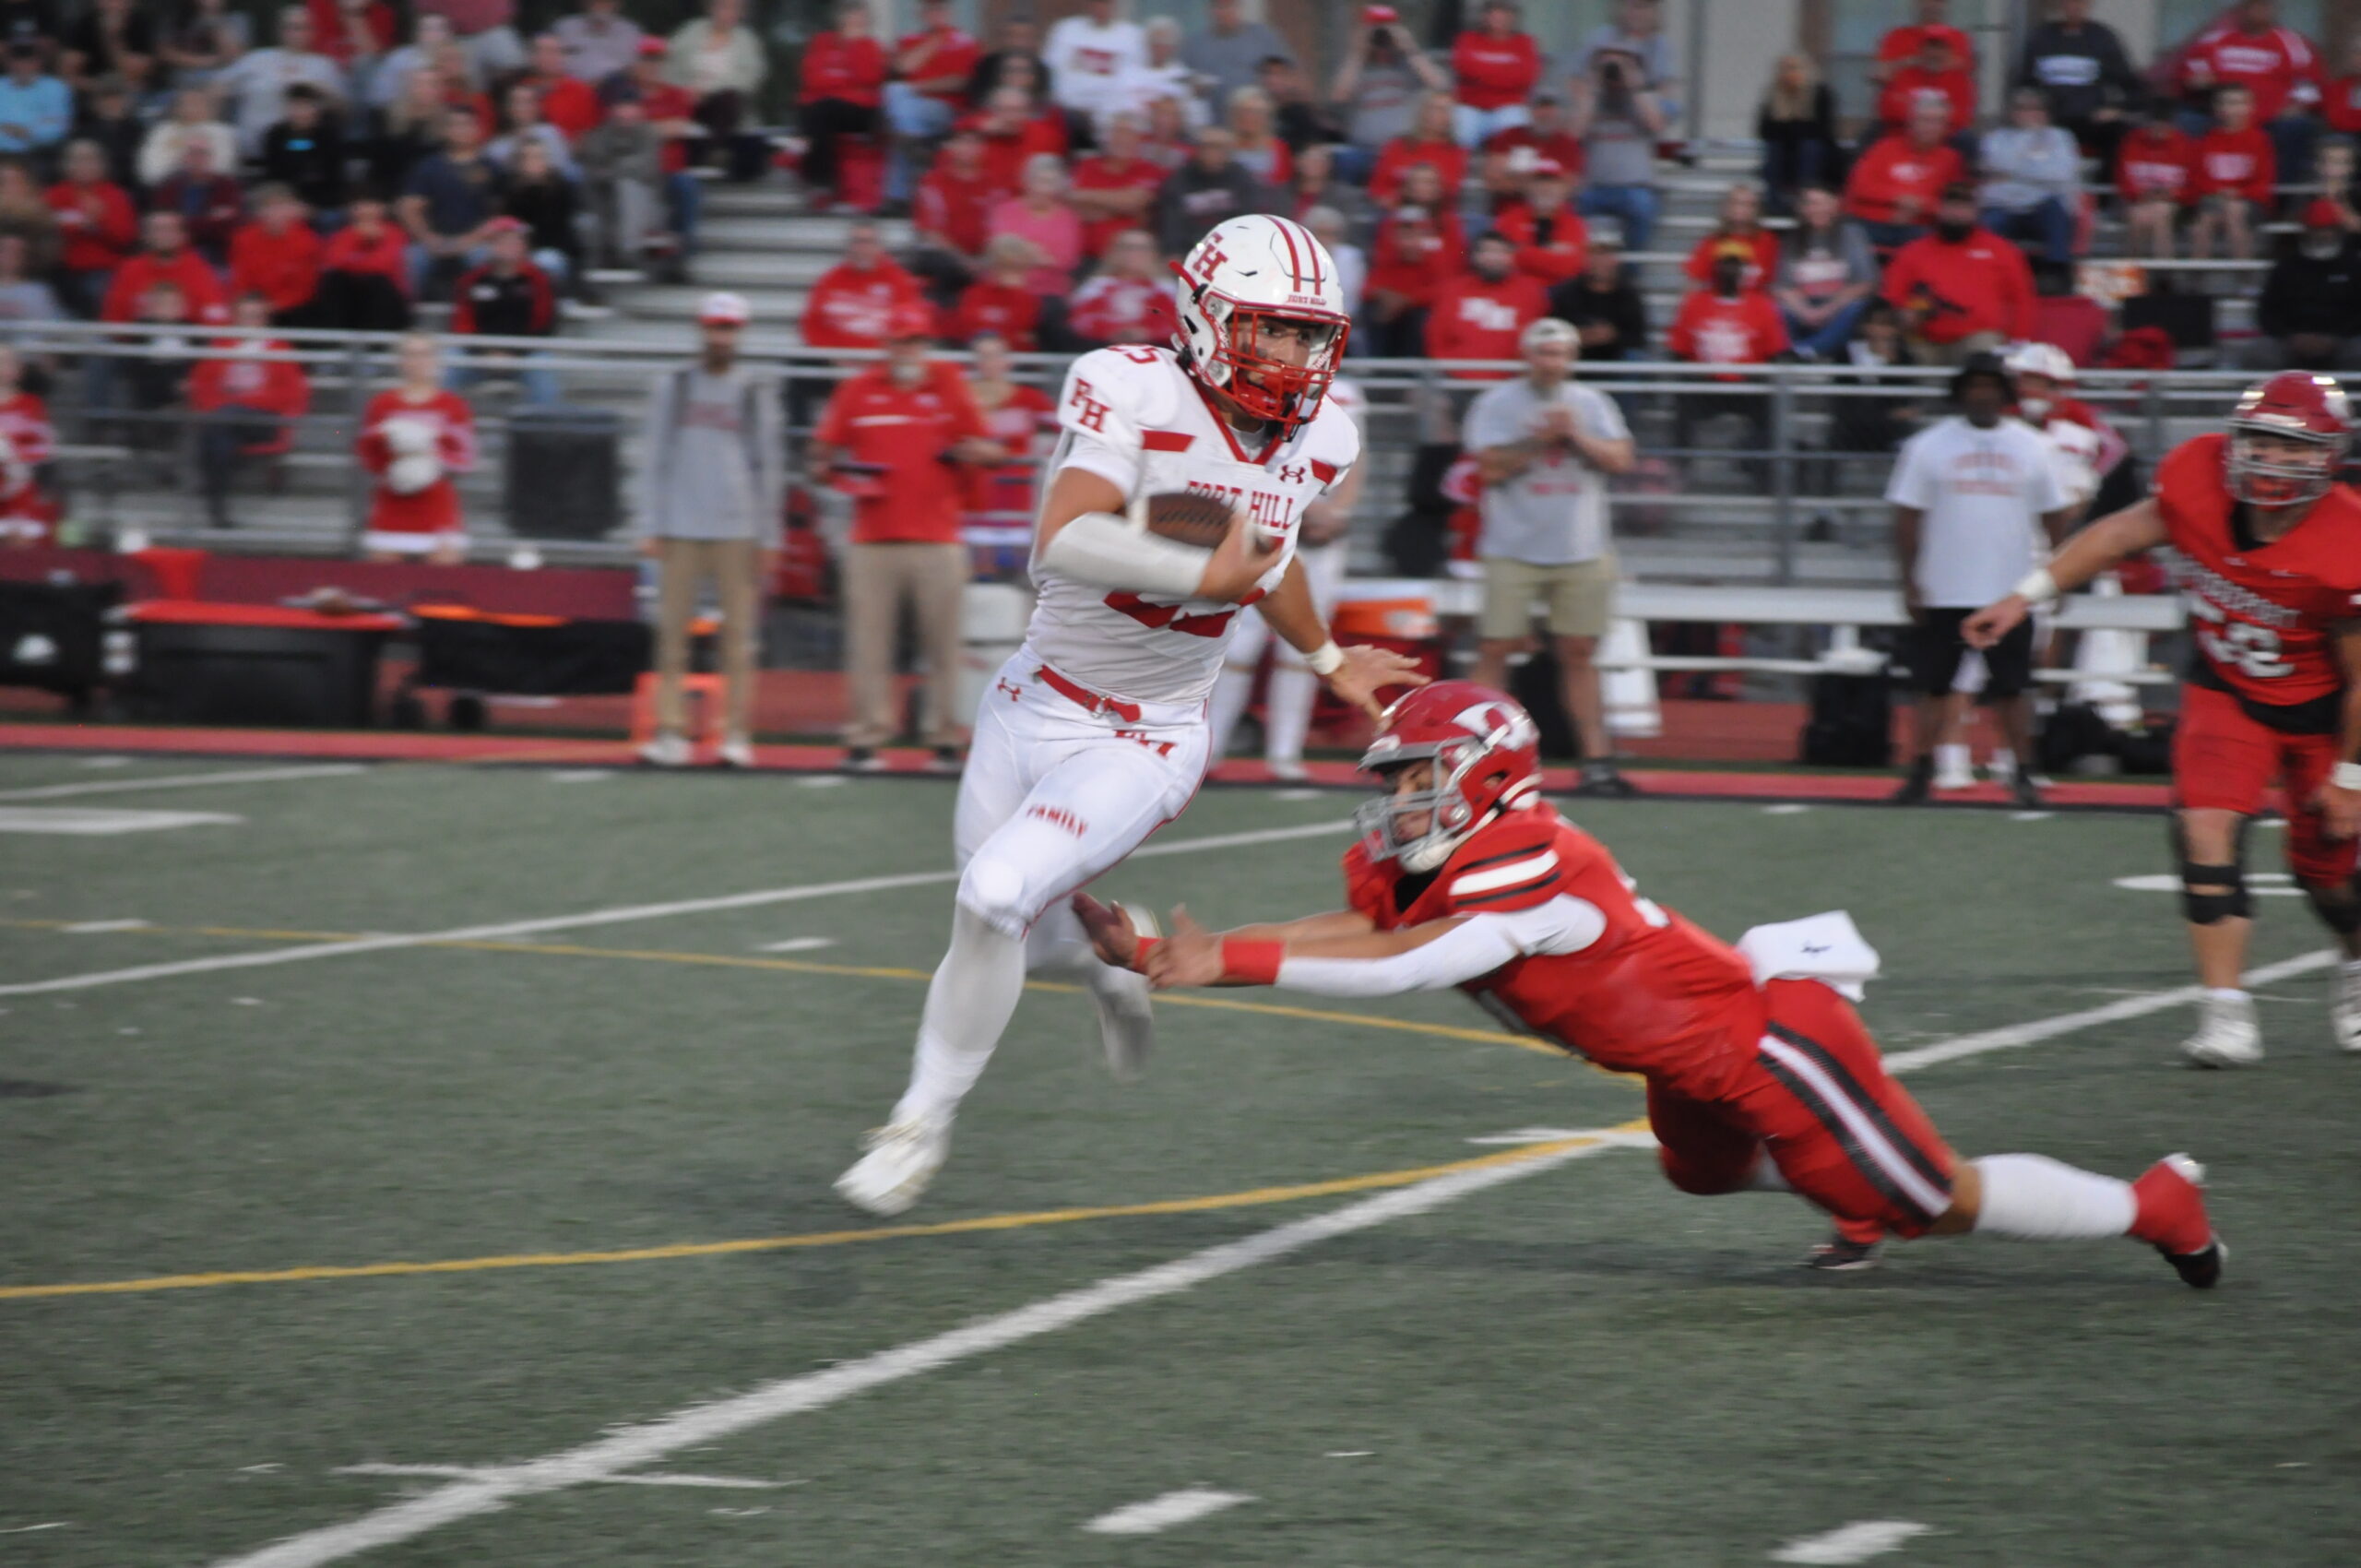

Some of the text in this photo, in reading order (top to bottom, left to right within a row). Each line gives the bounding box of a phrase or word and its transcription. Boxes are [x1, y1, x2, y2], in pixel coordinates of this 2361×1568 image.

[1108, 345, 1158, 364] 5
[1248, 490, 1293, 530] HILL
[1026, 803, 1089, 839] FAMILY
